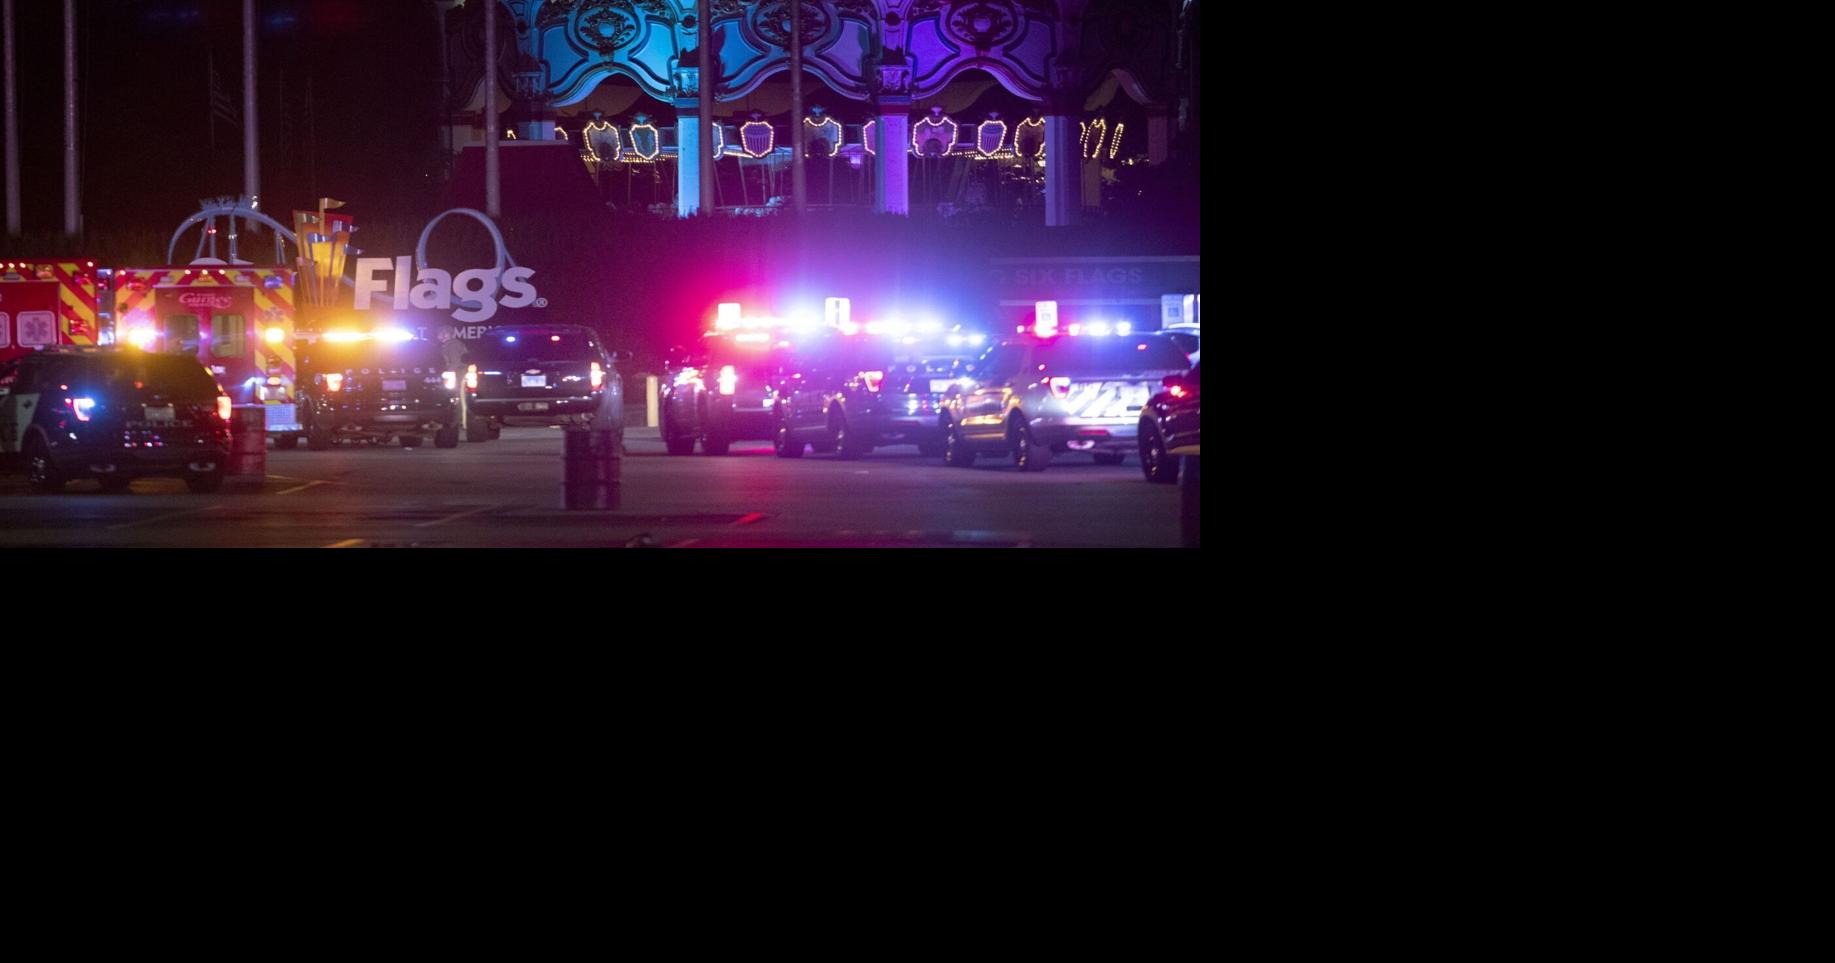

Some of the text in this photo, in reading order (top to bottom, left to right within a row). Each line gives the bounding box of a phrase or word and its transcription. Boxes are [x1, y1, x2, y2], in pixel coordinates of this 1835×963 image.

[353, 255, 537, 323] Flags
[1015, 268, 1056, 285] SIX
[1064, 267, 1142, 285] FLAGS
